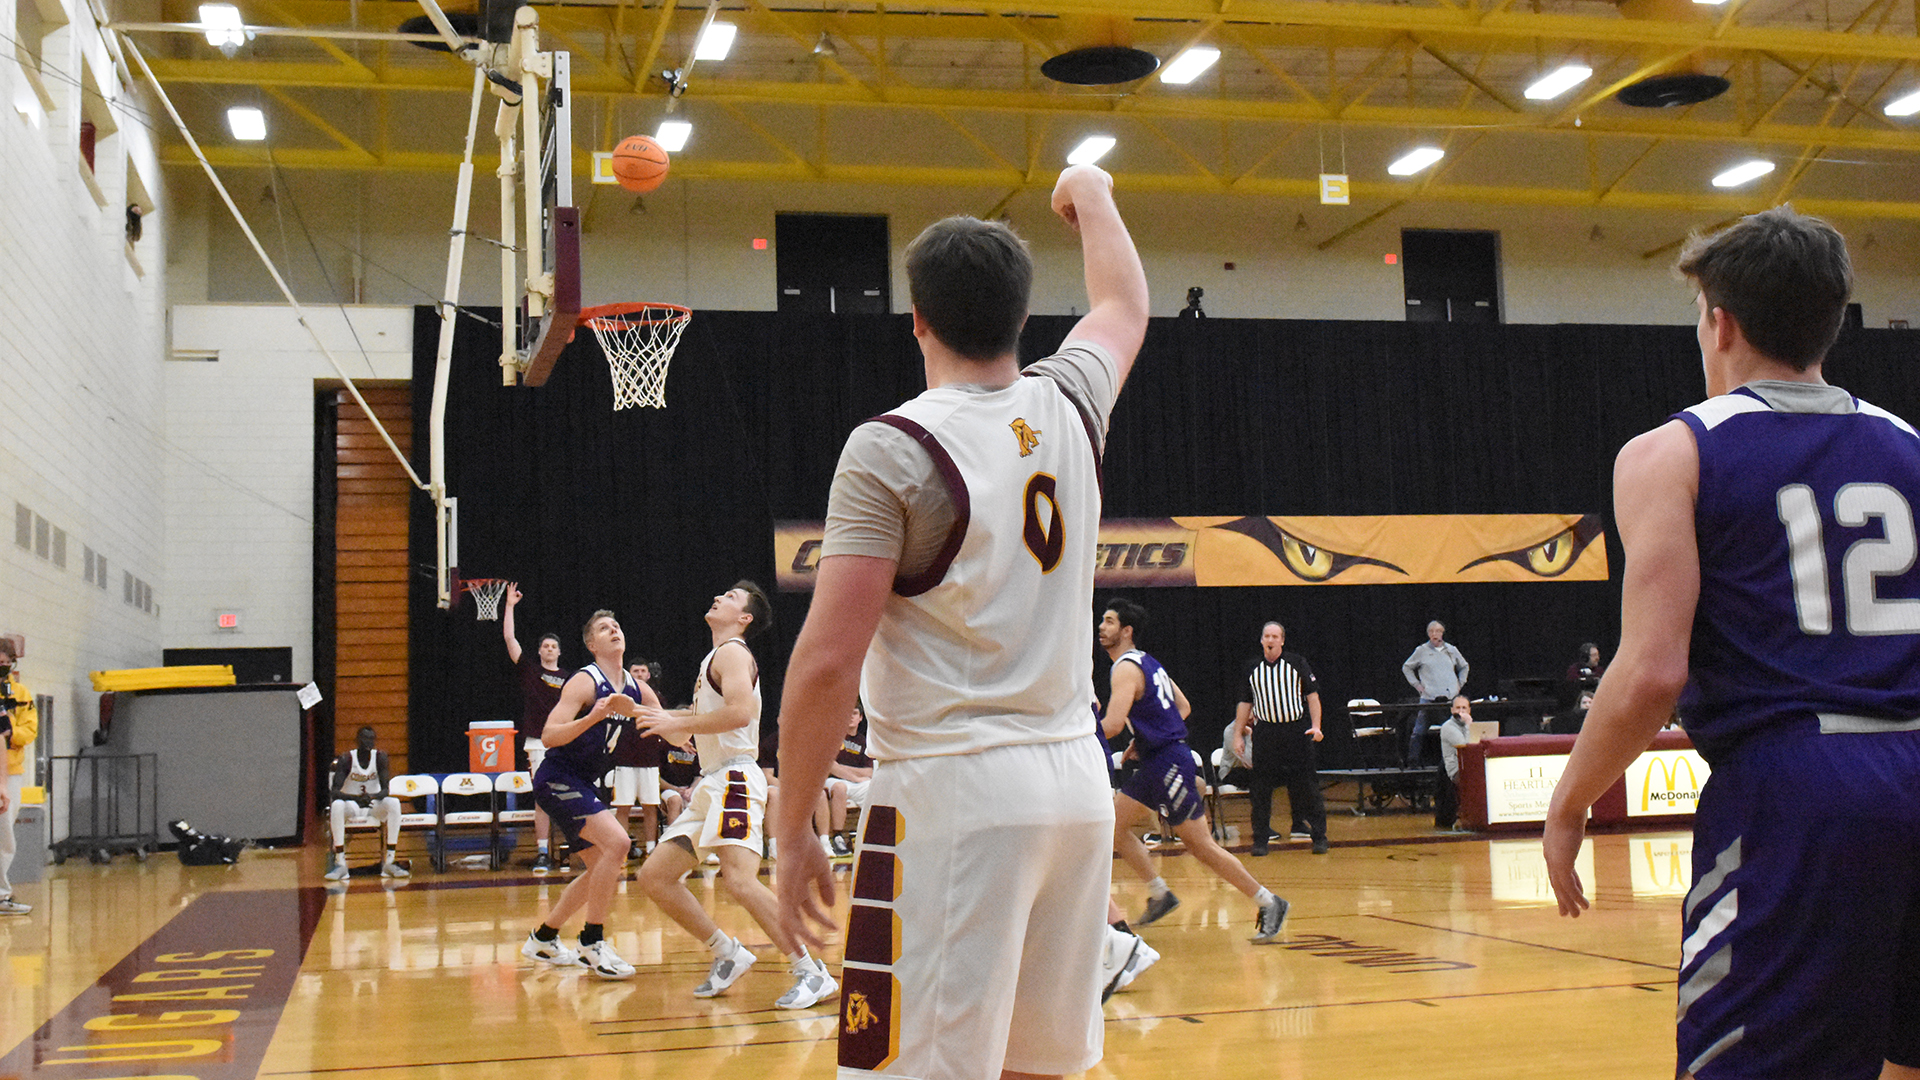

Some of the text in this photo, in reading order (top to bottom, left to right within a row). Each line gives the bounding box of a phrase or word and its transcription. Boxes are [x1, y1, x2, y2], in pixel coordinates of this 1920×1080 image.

[1321, 175, 1348, 203] E
[1022, 471, 1066, 575] 0
[1096, 542, 1188, 569] TICS
[1776, 482, 1920, 636] 12
[481, 736, 496, 753] G
[1650, 791, 1700, 801] McDonal
[40, 948, 275, 1080] UGARS
